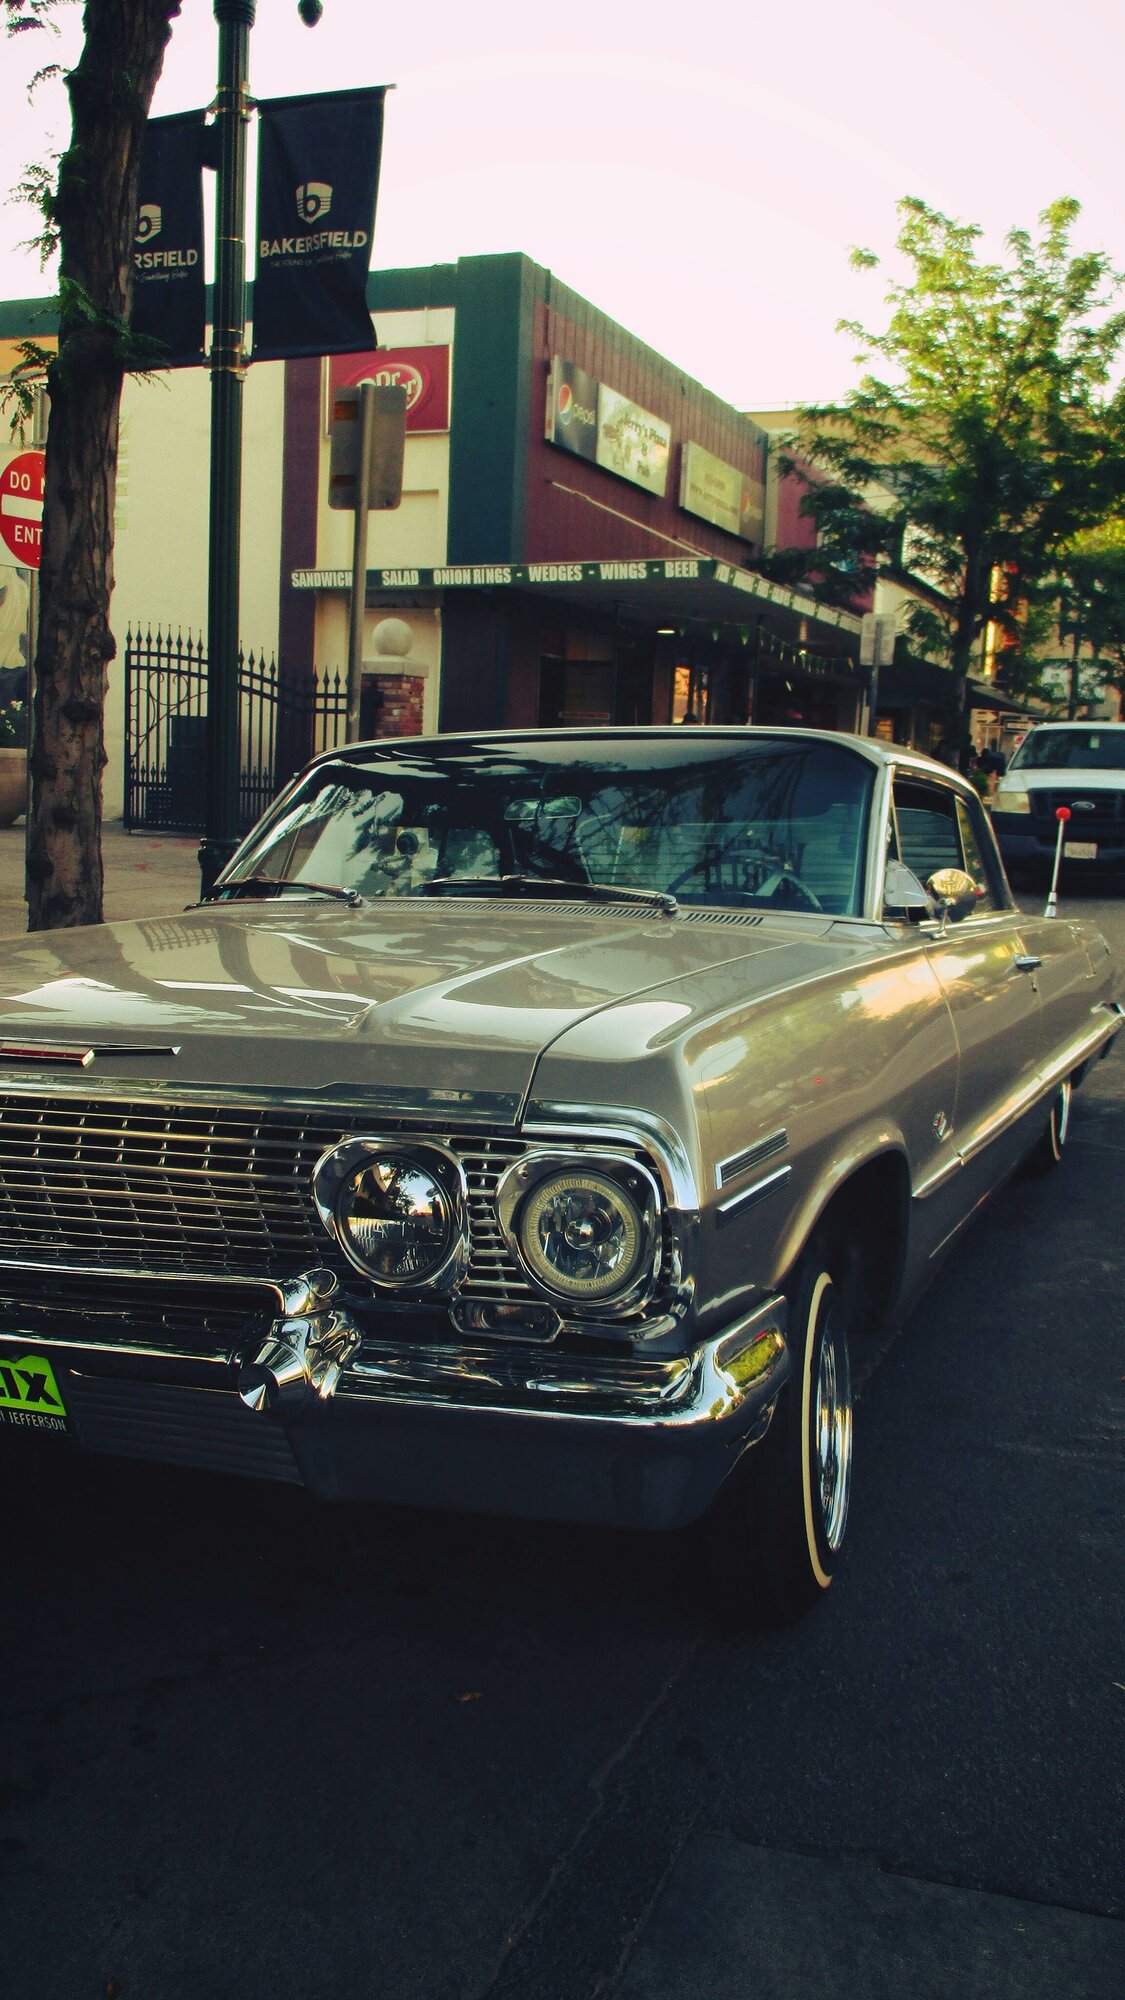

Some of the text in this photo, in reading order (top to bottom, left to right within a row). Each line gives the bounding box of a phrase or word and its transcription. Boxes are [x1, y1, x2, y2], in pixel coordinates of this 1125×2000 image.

[260, 230, 368, 258] BAKERSFIELD
[573, 403, 596, 426] pepsi
[10, 471, 31, 492] DO
[14, 525, 43, 545] ENT
[382, 569, 419, 586] SALAD
[432, 568, 472, 585] ONION
[473, 566, 512, 584] RINGS
[527, 564, 583, 582] WEDGES
[599, 562, 648, 580] WINGS
[664, 560, 699, 578] BEER
[0, 1367, 60, 1407] IX
[9, 1411, 67, 1432] JEFFERSON
